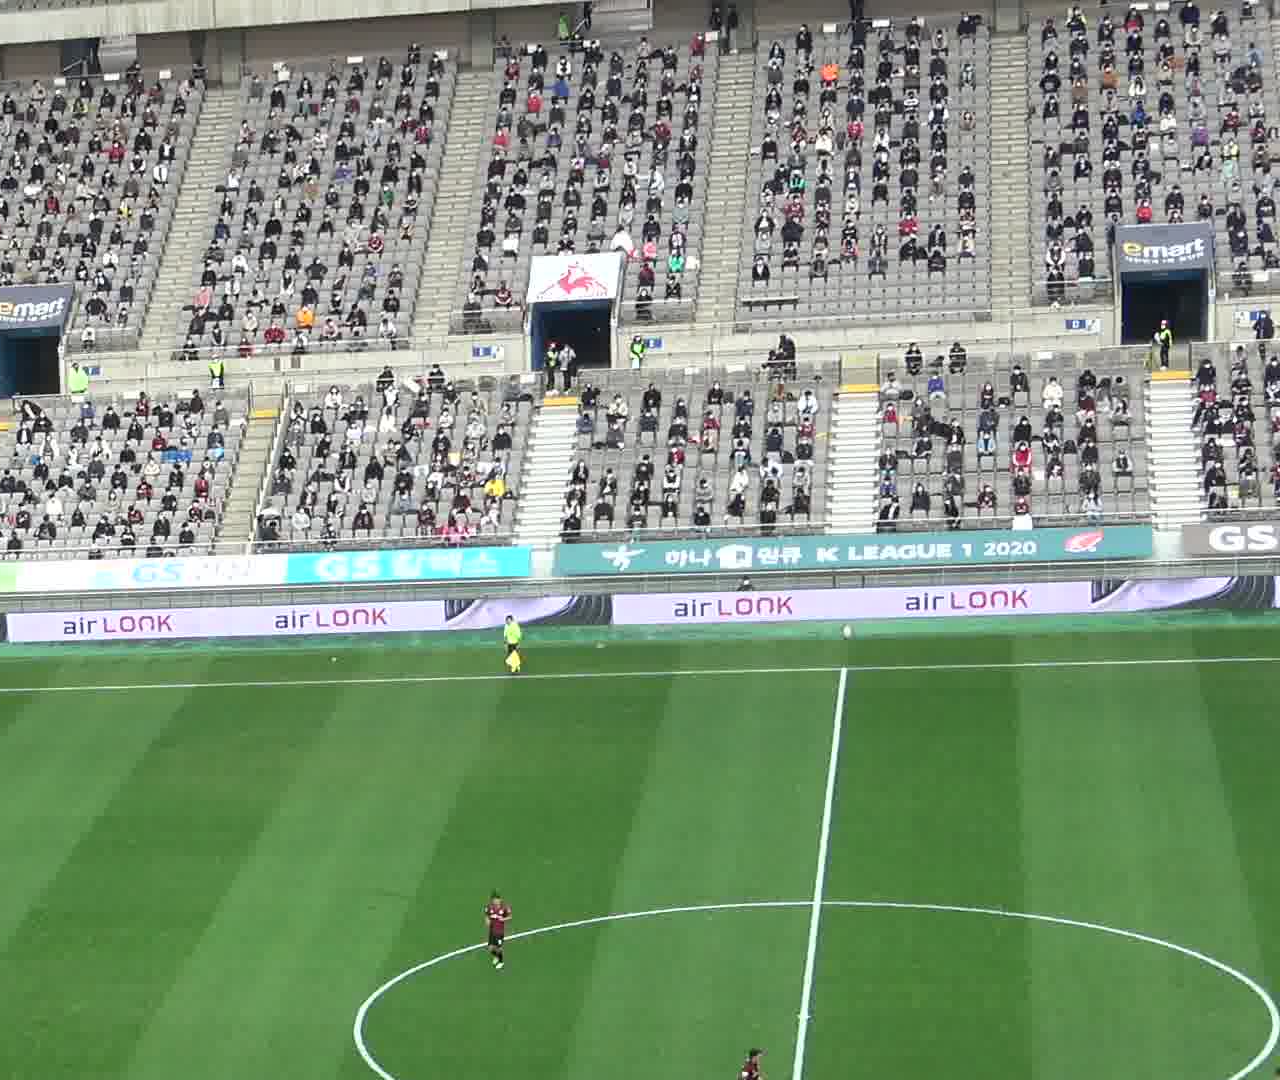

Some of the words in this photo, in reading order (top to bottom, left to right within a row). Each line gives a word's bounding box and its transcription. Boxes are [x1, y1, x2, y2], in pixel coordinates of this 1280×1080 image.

[1209, 525, 1278, 551] GS
[816, 547, 839, 562] K
[848, 543, 952, 561] LEAGUE
[961, 543, 973, 558] 1
[984, 541, 1038, 556] 2020
[315, 554, 380, 581] GS
